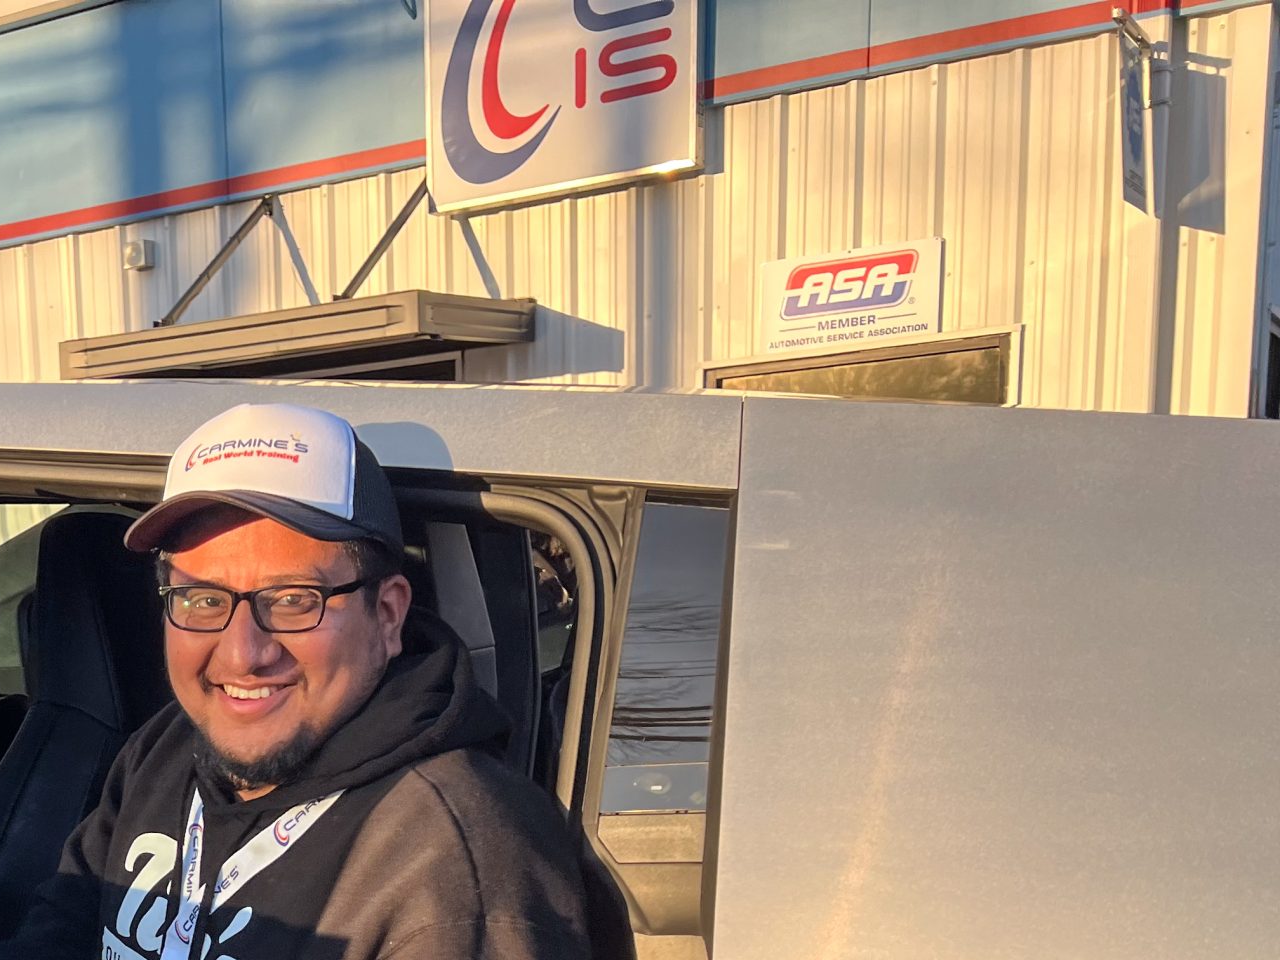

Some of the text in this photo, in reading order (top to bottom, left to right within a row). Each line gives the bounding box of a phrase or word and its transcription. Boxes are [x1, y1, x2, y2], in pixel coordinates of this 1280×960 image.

[790, 262, 908, 309] ASA
[817, 314, 877, 331] MEMBER
[769, 322, 929, 349] AUTOMOTIVE SERVICE ASSOCIATION
[197, 438, 309, 459] CARMINE'S
[202, 450, 300, 465] Real World Training
